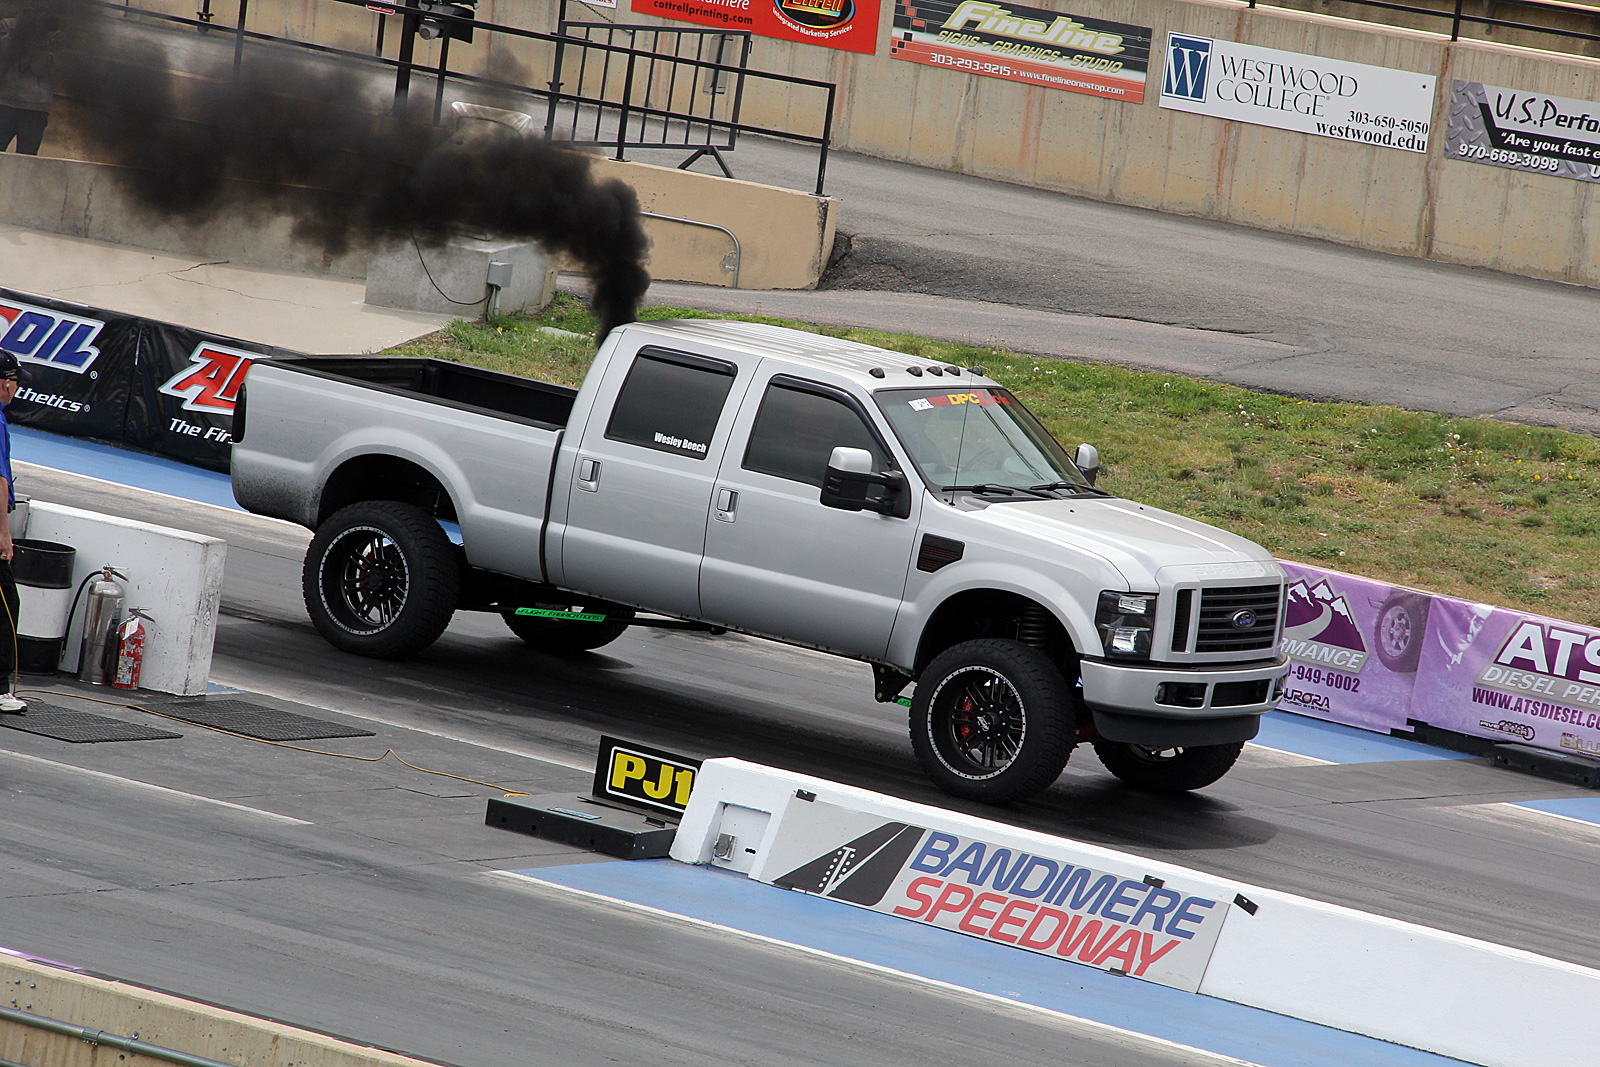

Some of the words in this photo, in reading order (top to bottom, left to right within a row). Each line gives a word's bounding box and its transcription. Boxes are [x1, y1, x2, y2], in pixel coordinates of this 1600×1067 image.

[654, 0, 753, 24] cottrellprinting.com
[773, 7, 800, 32] Integrated
[800, 27, 829, 39] Marketing
[830, 24, 853, 37] Services
[936, 30, 980, 48] SIGNS
[990, 40, 1061, 63] GRAPHICS
[1070, 54, 1124, 74] STUDIO
[929, 52, 1011, 77] 303-293-9215
[1019, 69, 1125, 95] www.finelineonestop.com
[1220, 54, 1358, 98] WESTWOOD
[1216, 78, 1326, 117] COLLEGE
[1316, 120, 1426, 152] westwood.edu
[1347, 110, 1429, 135] 303-650-5050
[1459, 143, 1559, 172] 970-669-3098
[1532, 140, 1560, 152] you
[1562, 141, 1591, 157] fast
[0, 302, 104, 373] OIL
[169, 418, 201, 437] The
[654, 431, 682, 448] Wesley
[682, 438, 707, 453] Beech
[1288, 663, 1361, 693] -949-6002
[1481, 666, 1556, 696] DIESEL
[1284, 687, 1330, 708] URORA
[611, 752, 693, 806] PJ1
[909, 830, 1216, 940] BANDIMERE
[893, 876, 1182, 977] SPEEDWAY
